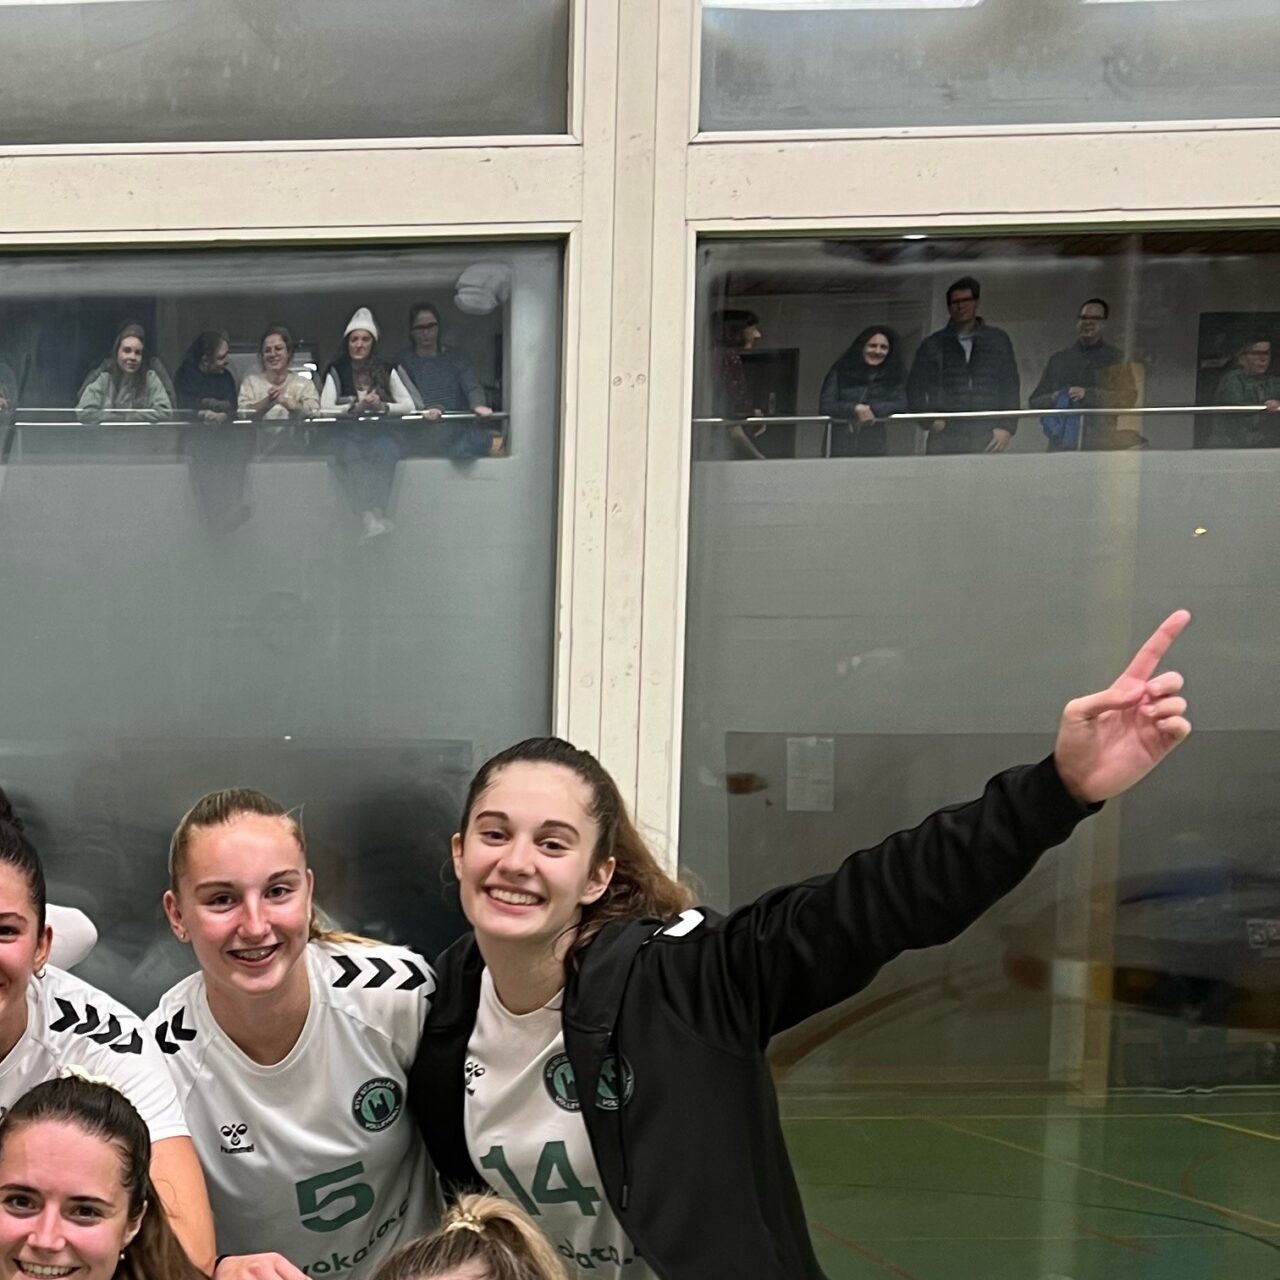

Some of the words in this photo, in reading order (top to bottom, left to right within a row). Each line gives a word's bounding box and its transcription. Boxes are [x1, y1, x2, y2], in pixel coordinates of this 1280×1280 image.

[220, 1144, 254, 1154] hummel
[479, 1140, 602, 1217] 14
[295, 1160, 376, 1233] 5
